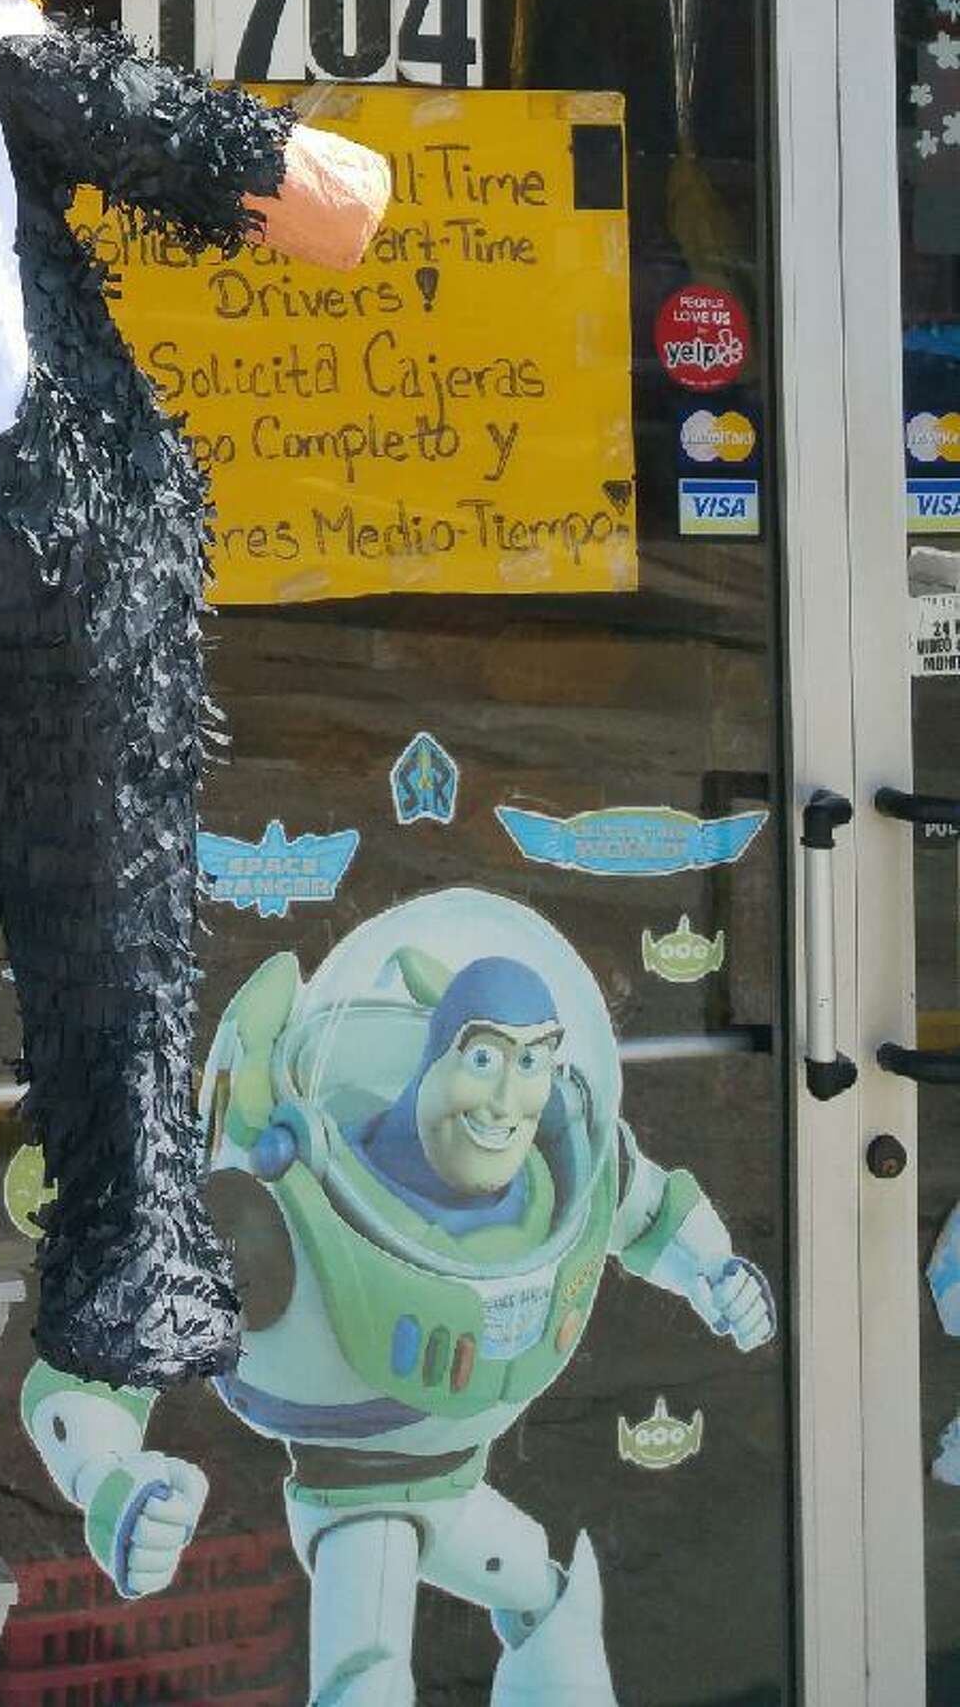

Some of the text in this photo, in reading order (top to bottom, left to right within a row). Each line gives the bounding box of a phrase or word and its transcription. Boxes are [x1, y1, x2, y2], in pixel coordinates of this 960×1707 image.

[680, 296, 724, 309] PEOPLE
[673, 310, 731, 325] LOVE US
[665, 339, 719, 370] yelp
[149, 330, 545, 434] Solicita Cajeras
[484, 422, 519, 481] y
[693, 496, 746, 517] VISA
